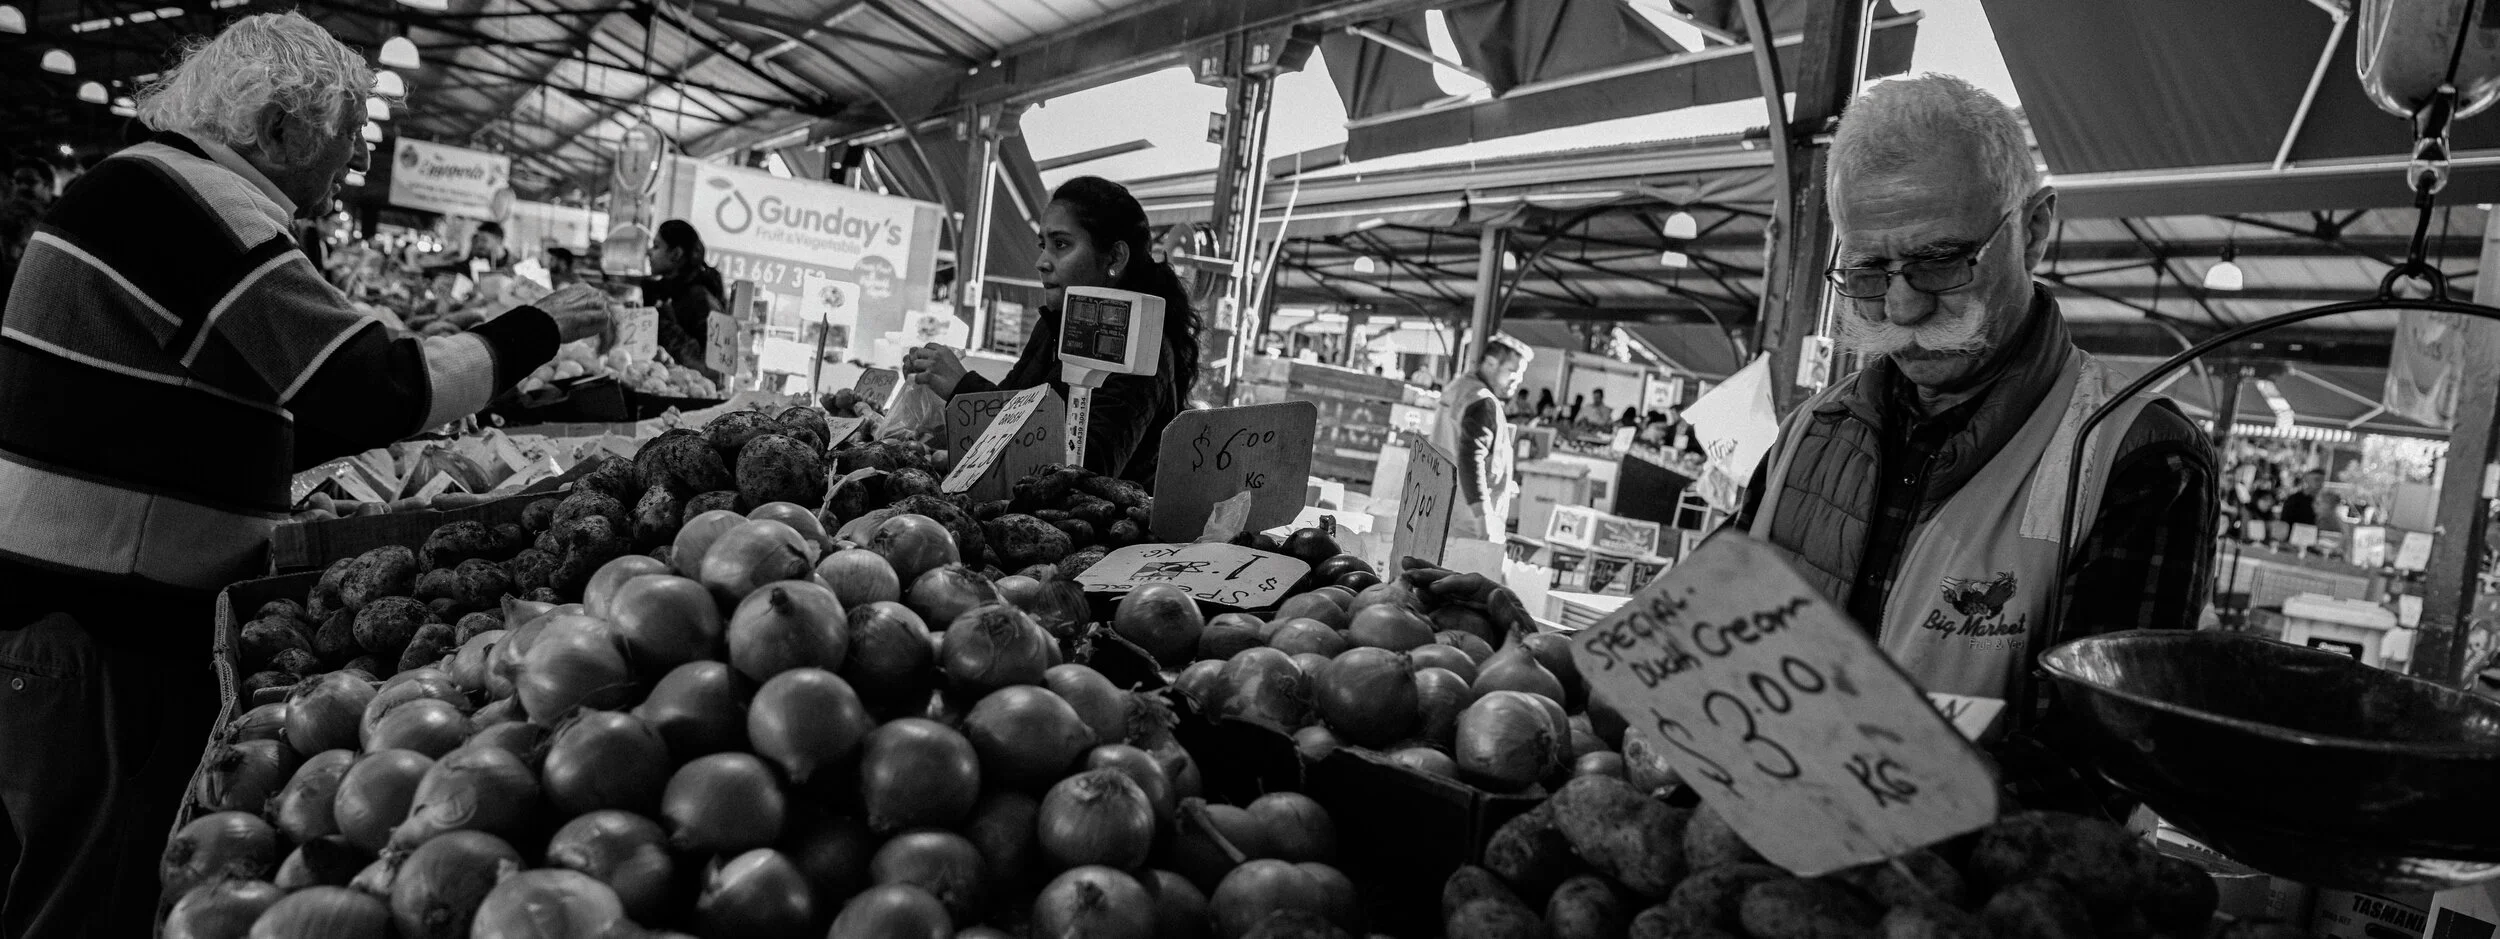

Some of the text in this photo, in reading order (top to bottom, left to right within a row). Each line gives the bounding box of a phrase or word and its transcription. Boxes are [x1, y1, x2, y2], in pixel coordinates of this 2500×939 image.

[758, 195, 901, 248] Gunday's
[751, 260, 786, 285] 667
[997, 410, 1027, 426] BRUSH
[1003, 390, 1040, 412] SPECIAL
[1192, 424, 1275, 473] $6.00
[1413, 439, 1441, 477] SPECIAL
[1692, 596, 1813, 657] Cream
[1921, 608, 2027, 640] Big Market
[1994, 639, 2004, 651] &
[1649, 656, 1826, 799] $3.00
[1843, 754, 1919, 808] KG
